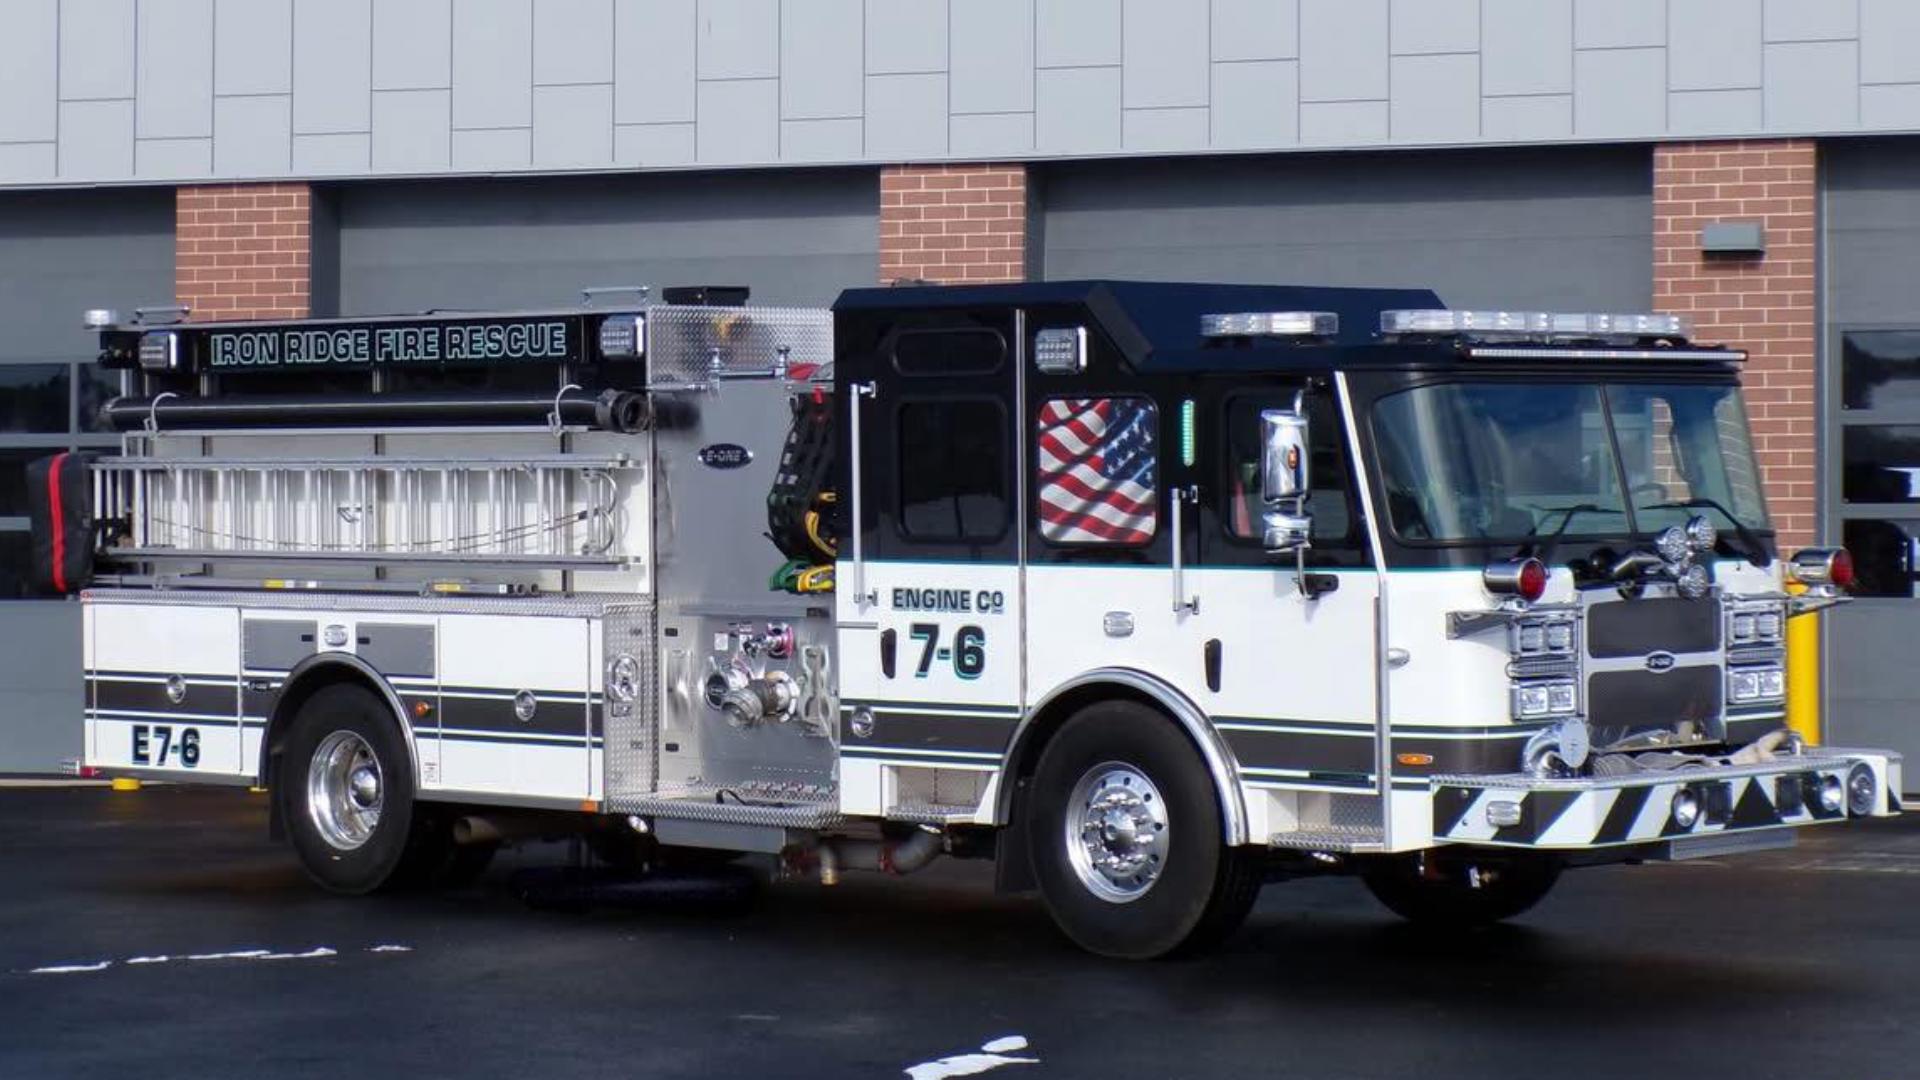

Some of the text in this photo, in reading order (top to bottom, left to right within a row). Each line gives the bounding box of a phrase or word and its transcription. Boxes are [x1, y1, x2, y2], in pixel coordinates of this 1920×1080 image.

[211, 322, 567, 366] IRON RIDGE FIRE RESCUE
[892, 588, 972, 613] ENGINE
[910, 623, 986, 680] 7-6
[132, 725, 201, 768] E7-6
